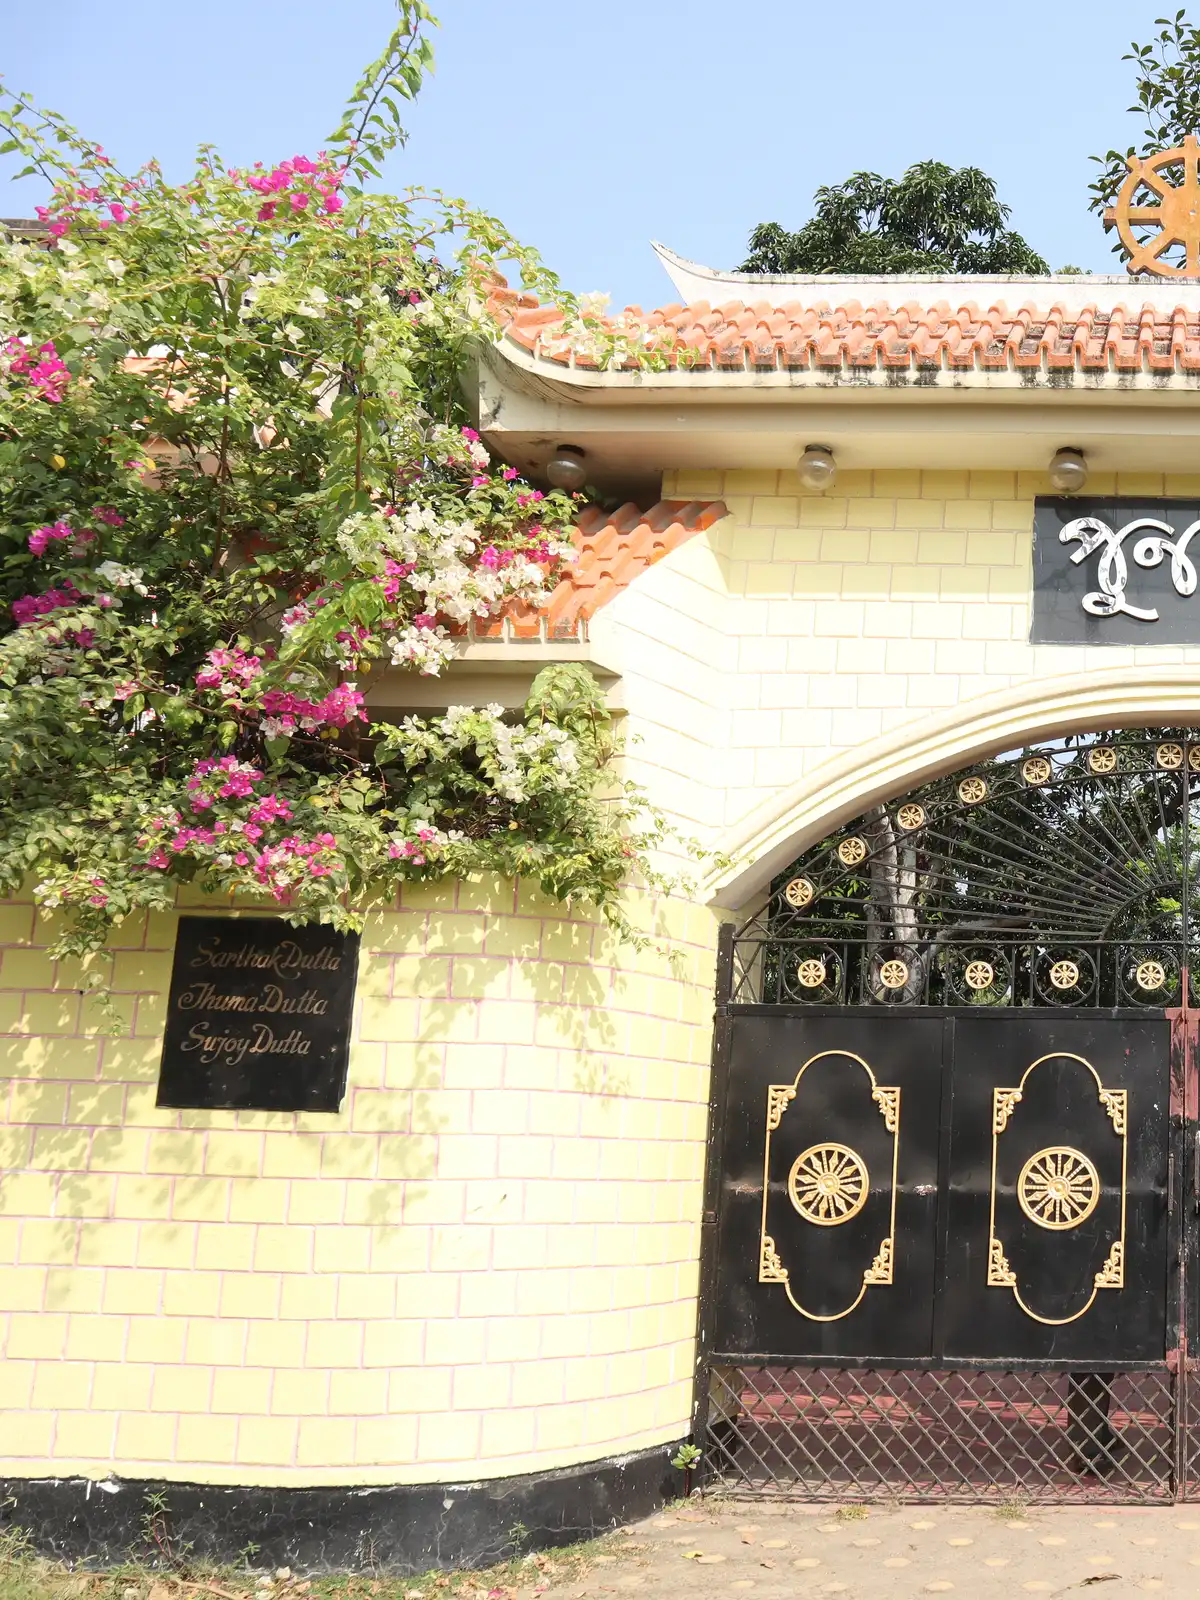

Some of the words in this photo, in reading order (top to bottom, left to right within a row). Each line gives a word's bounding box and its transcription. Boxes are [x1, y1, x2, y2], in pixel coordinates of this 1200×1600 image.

[191, 937, 300, 979] Sarthak
[281, 940, 342, 970] Dutta
[258, 984, 329, 1015] Dutta
[180, 1021, 249, 1066] Sujoy
[249, 1023, 312, 1055] Dutta
